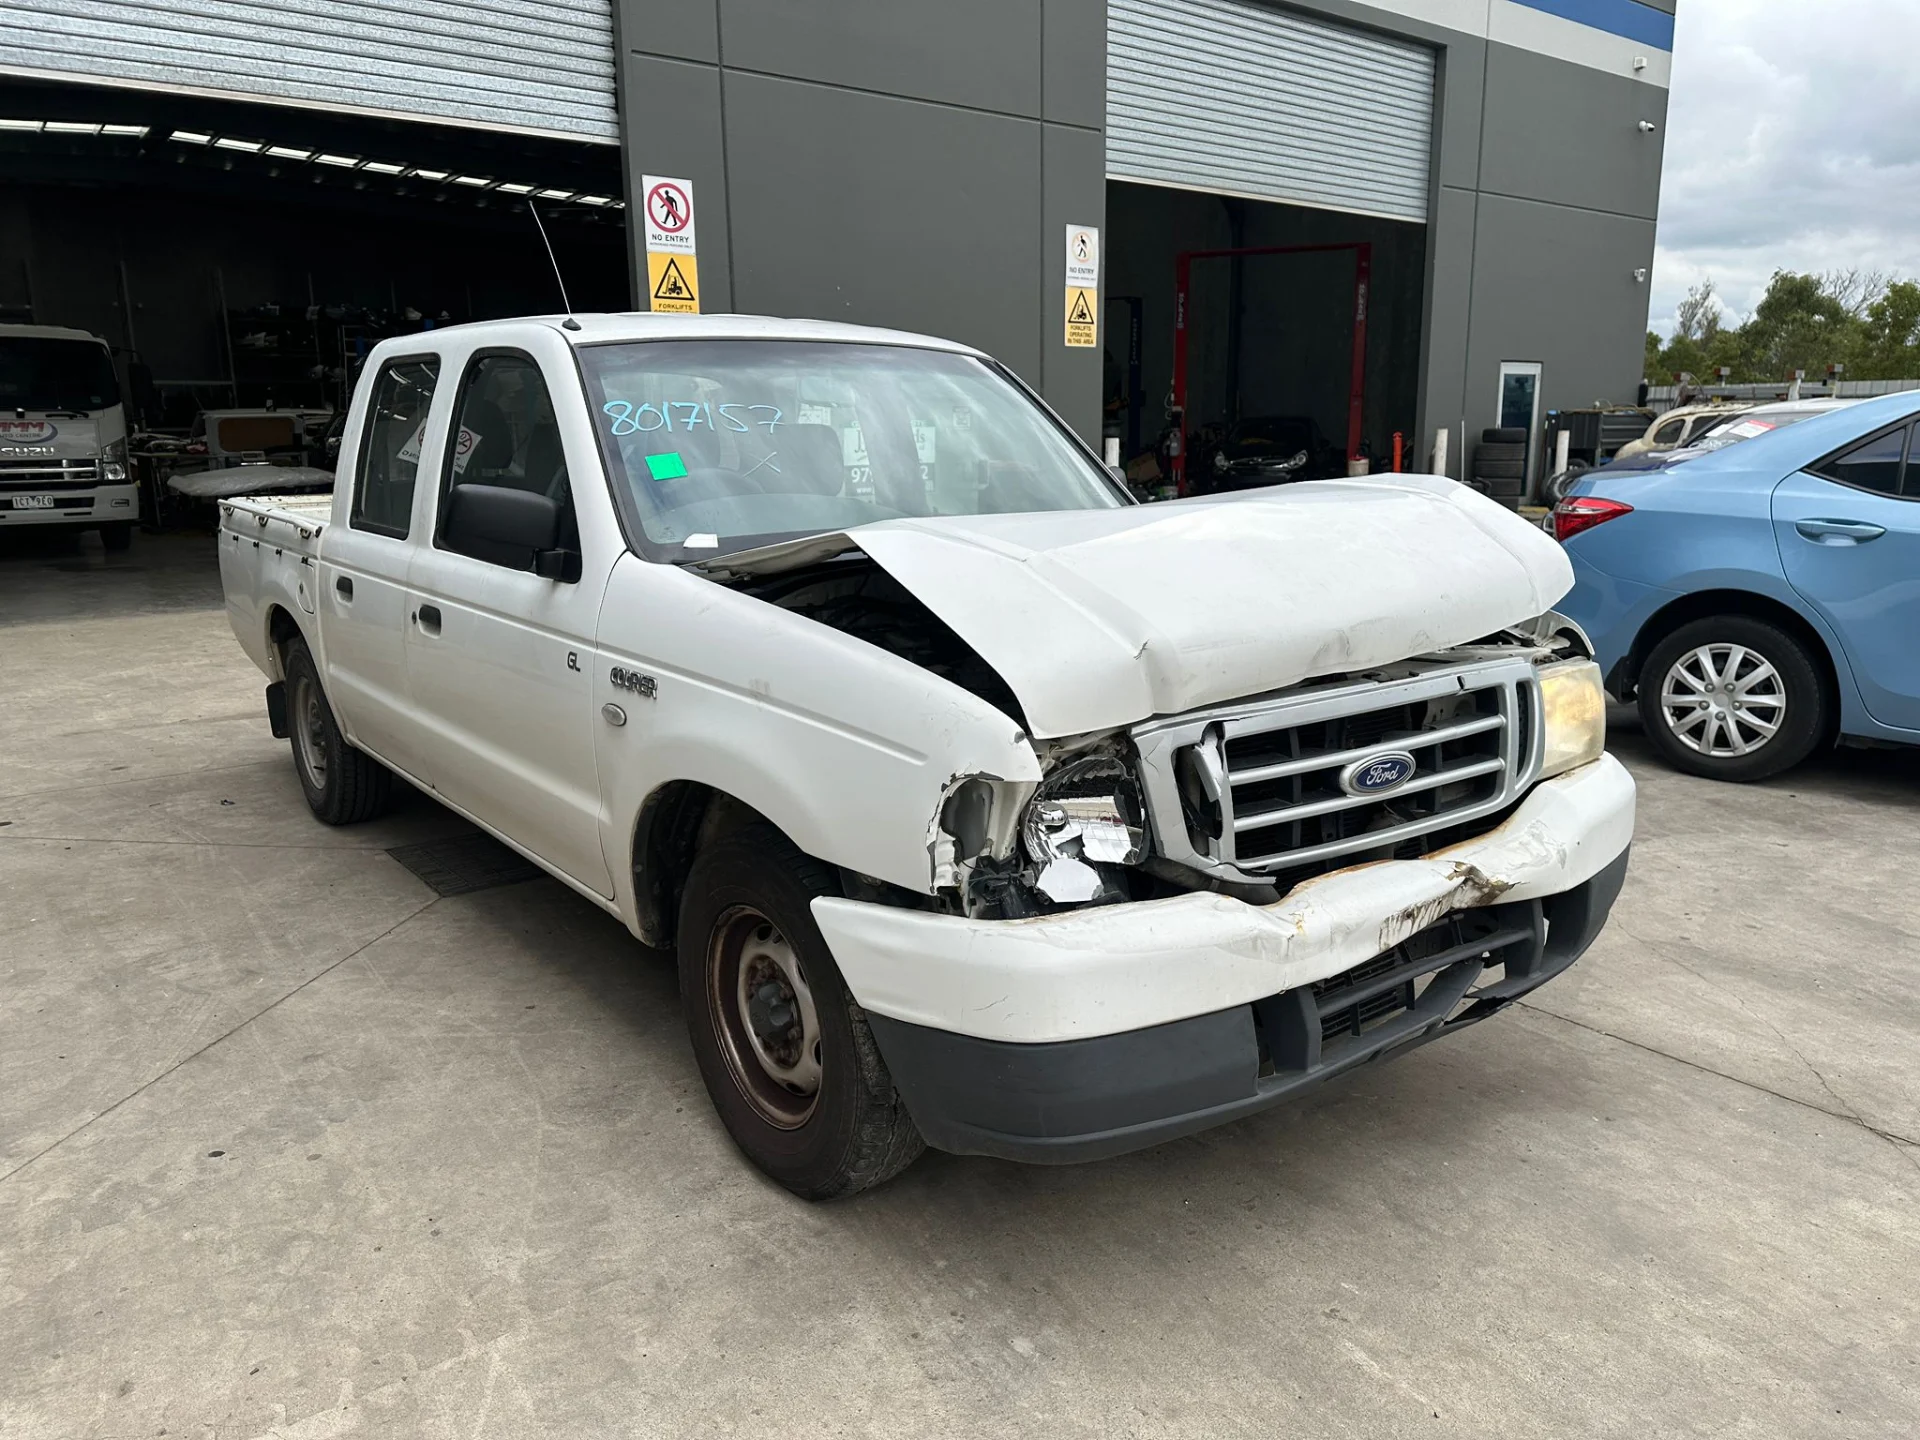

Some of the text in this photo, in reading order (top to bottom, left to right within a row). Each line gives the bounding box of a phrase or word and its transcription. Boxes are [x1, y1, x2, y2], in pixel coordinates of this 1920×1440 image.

[665, 234, 689, 243] ENTRY
[1078, 266, 1095, 274] ENTRY
[603, 400, 785, 436] 8017157
[0, 447, 54, 457] SUZU
[567, 651, 581, 673] GL
[610, 666, 659, 700] COURIER
[1366, 762, 1400, 785] Ford
